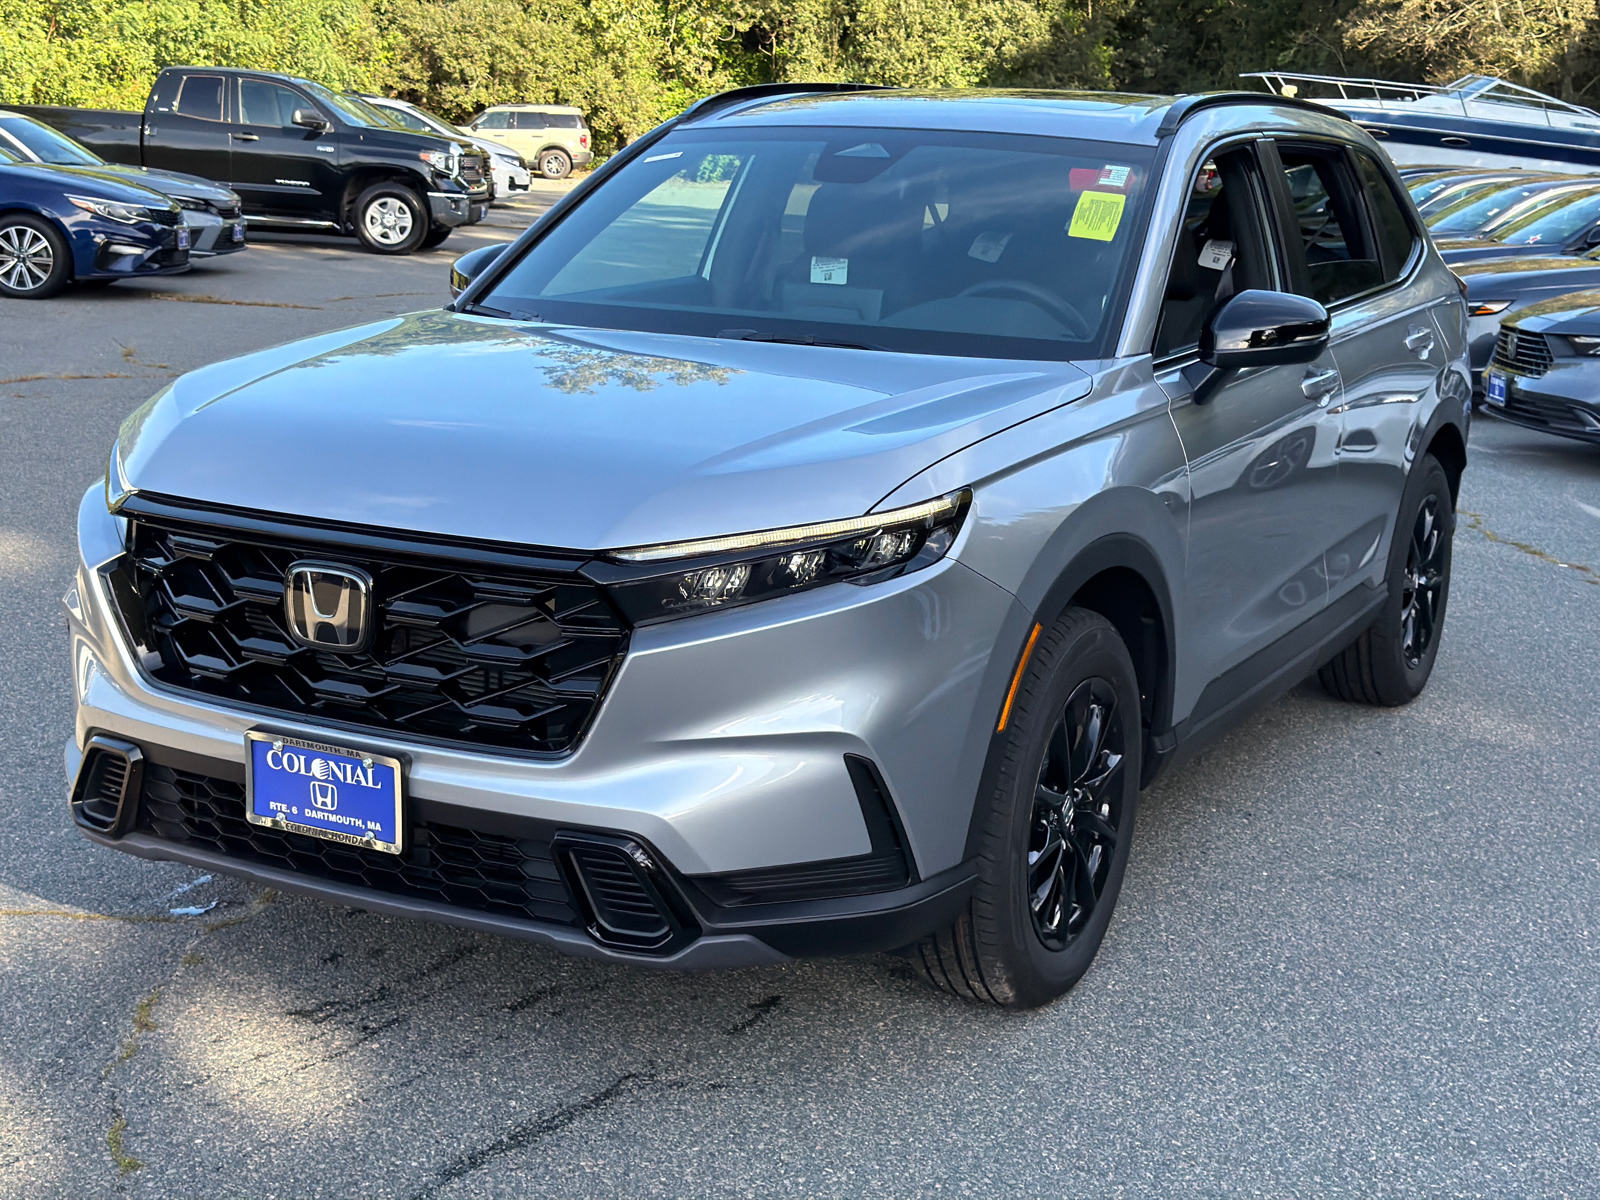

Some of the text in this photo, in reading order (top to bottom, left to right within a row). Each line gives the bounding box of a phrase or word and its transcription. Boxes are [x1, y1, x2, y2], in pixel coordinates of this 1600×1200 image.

[346, 750, 361, 758] MA
[266, 749, 381, 789] COLONIAL
[269, 801, 382, 831] RTE. 6 DARTMOUTH, MA
[331, 831, 364, 846] HONDA
